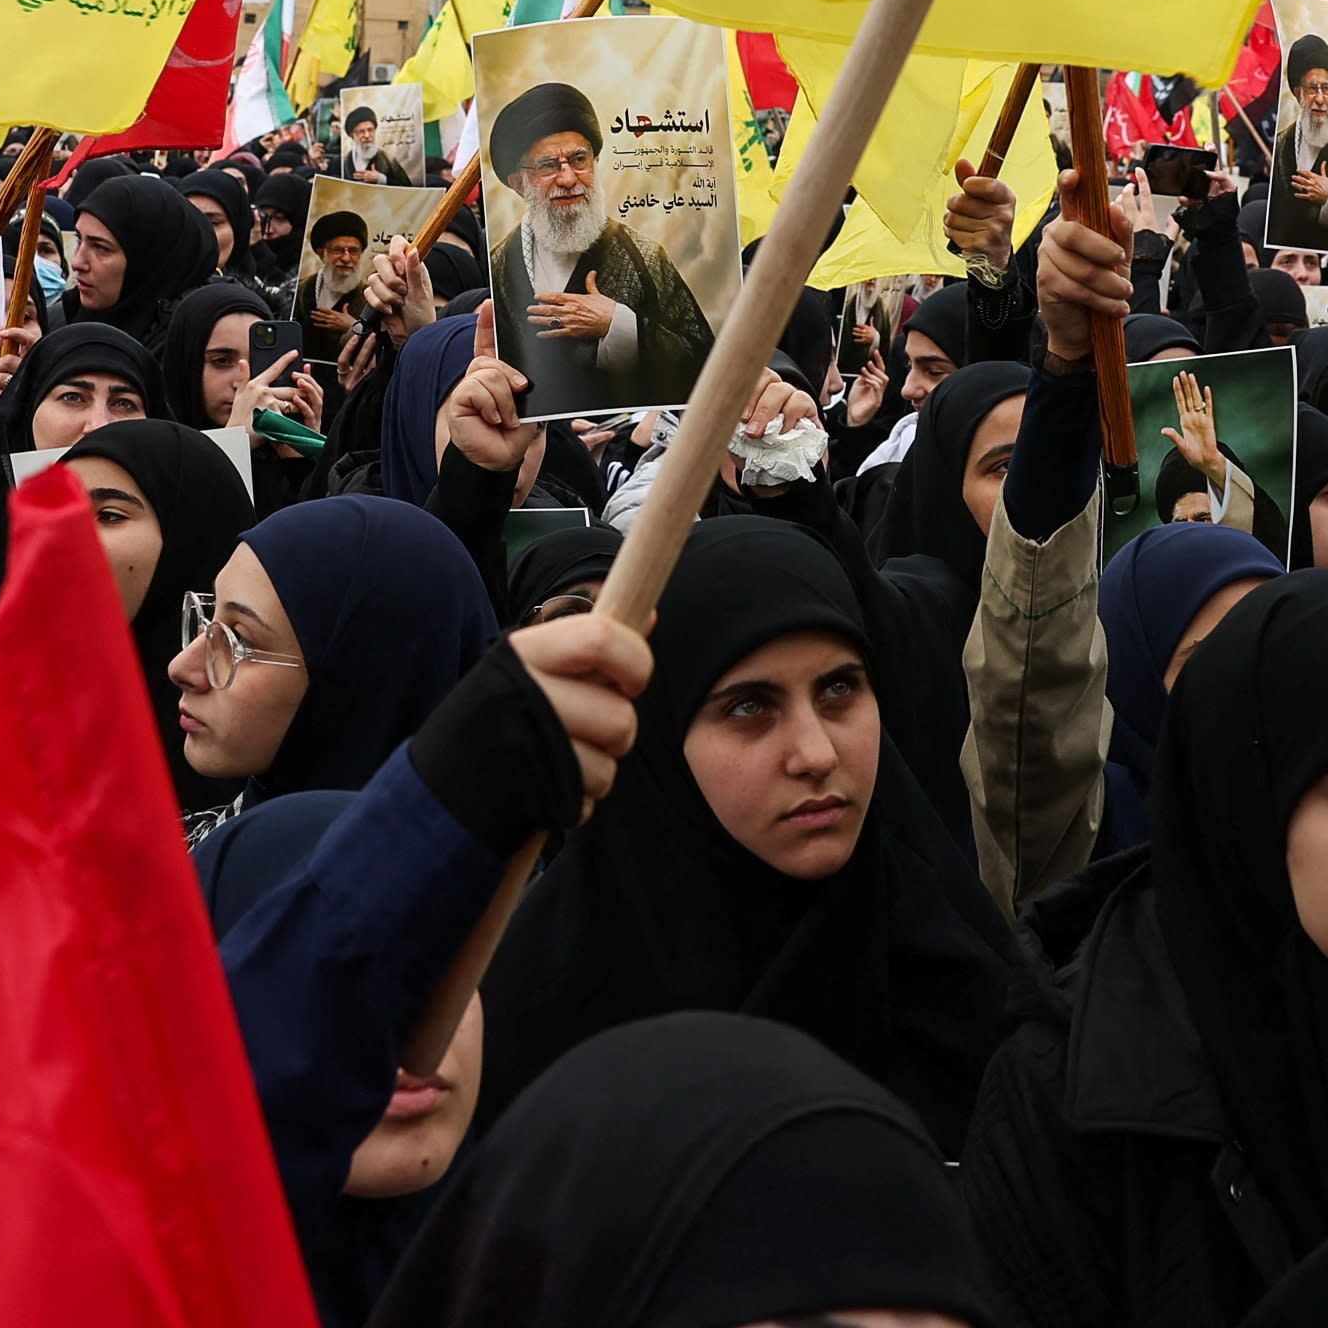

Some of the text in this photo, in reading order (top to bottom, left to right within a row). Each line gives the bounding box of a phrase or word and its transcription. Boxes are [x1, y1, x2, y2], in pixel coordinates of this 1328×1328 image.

[610, 108, 710, 138] استشهاد
[692, 173, 705, 189] الله
[618, 192, 718, 218] السيد علي خامنئي
